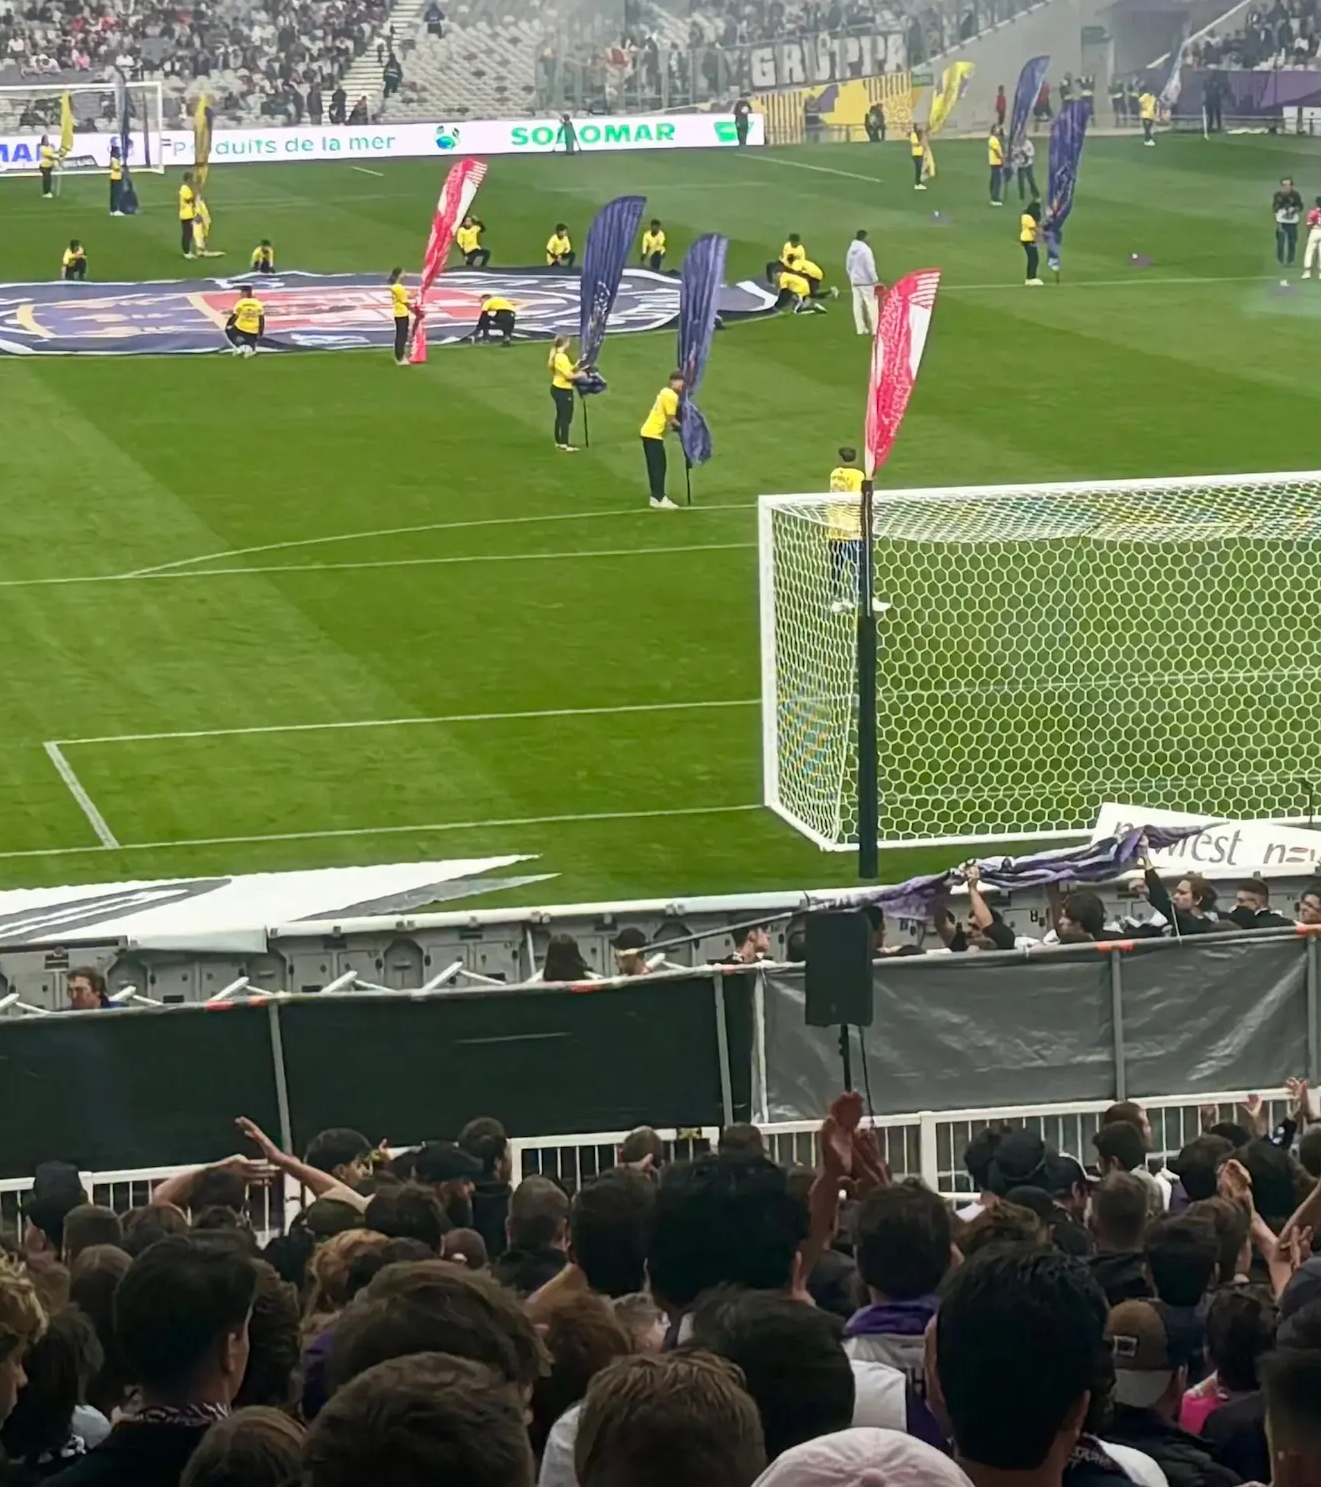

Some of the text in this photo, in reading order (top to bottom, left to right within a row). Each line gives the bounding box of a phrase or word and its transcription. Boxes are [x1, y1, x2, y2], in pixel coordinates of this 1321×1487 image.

[285, 136, 315, 152] de
[322, 135, 341, 151] la
[348, 134, 396, 150] mer
[511, 123, 675, 146] SOOMAR
